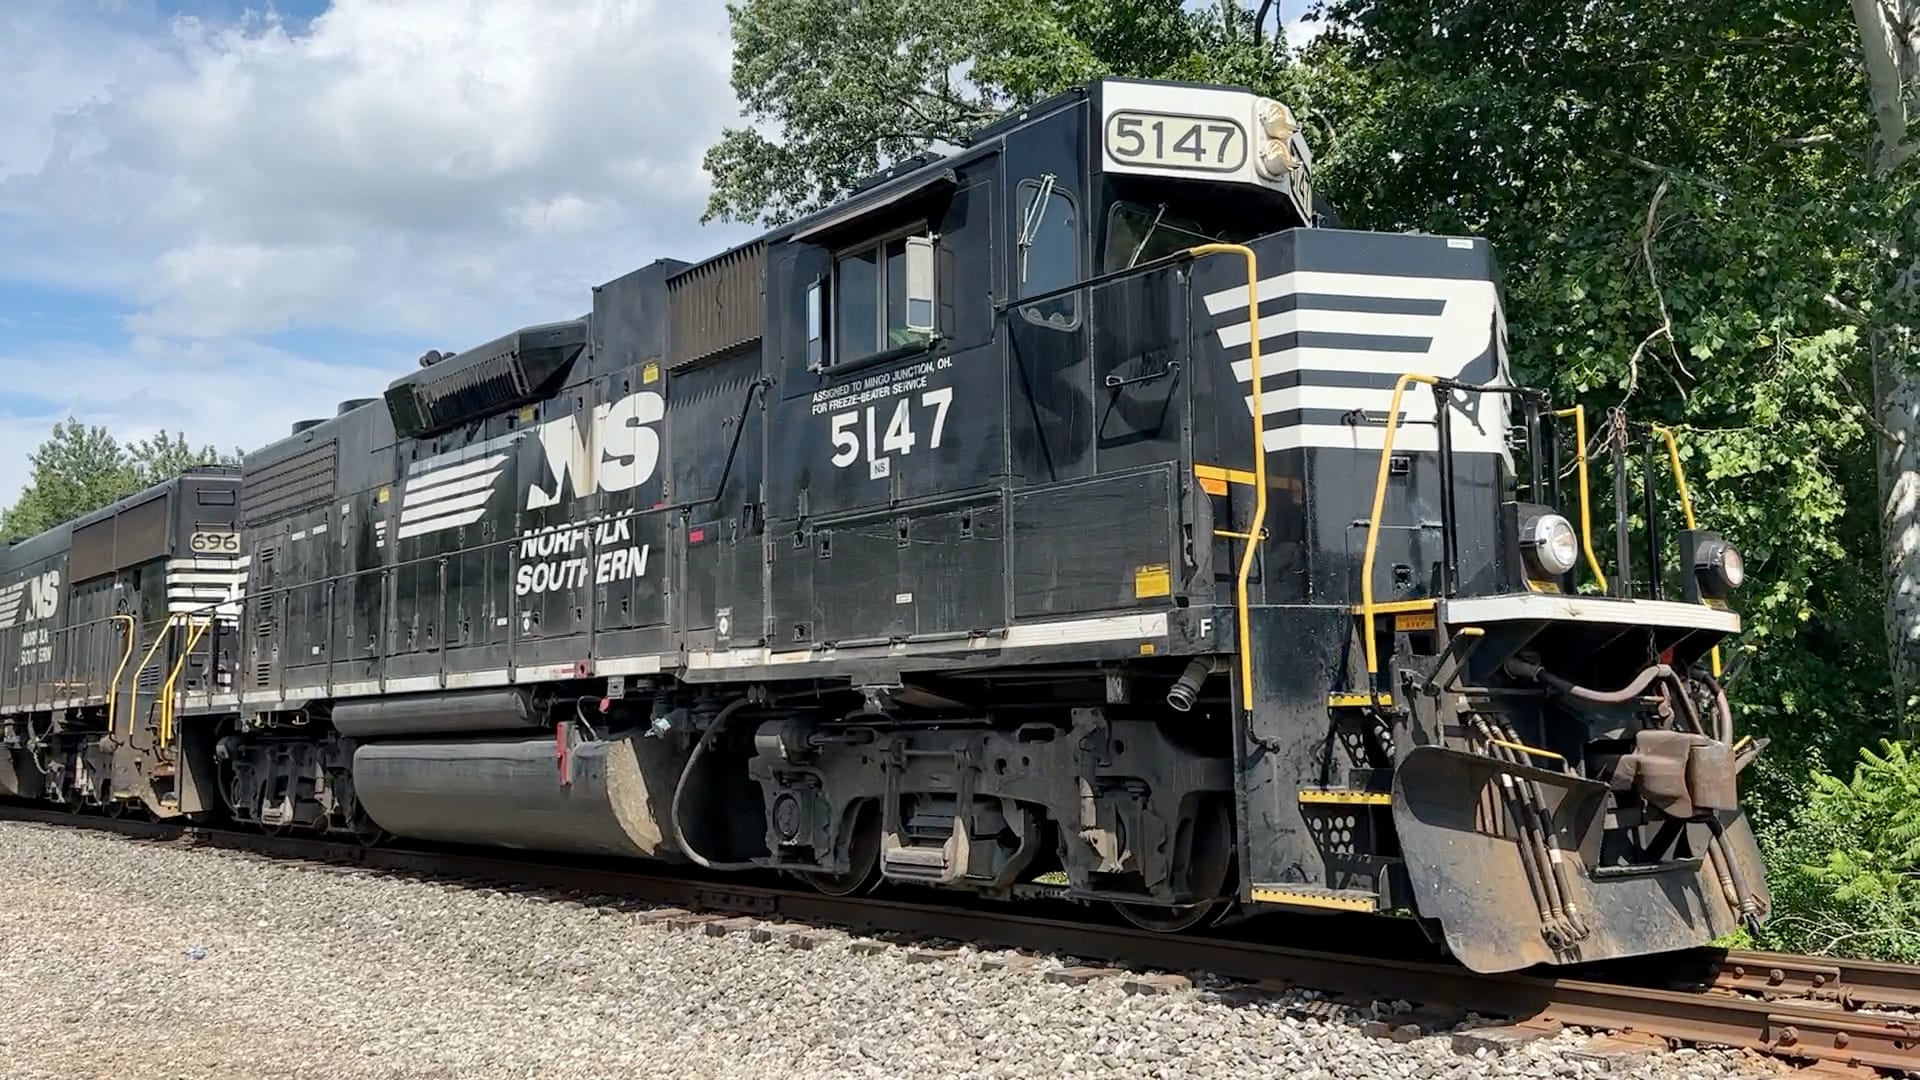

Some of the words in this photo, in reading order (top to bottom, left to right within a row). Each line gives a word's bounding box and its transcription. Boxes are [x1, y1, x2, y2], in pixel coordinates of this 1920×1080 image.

[1115, 117, 1235, 163] 5147
[812, 384, 850, 403] ASSIGNED
[851, 380, 862, 393] TO
[863, 373, 890, 389] MINGO
[892, 361, 935, 381] JUNCTION,
[937, 356, 953, 370] OH.
[812, 403, 828, 415] FOR
[892, 376, 928, 395] SERVICE
[526, 391, 665, 510] NS
[831, 387, 953, 468] 5147
[874, 463, 886, 474] NS
[192, 534, 237, 550] 696
[25, 570, 60, 622] NS
[1200, 618, 1212, 638] F
